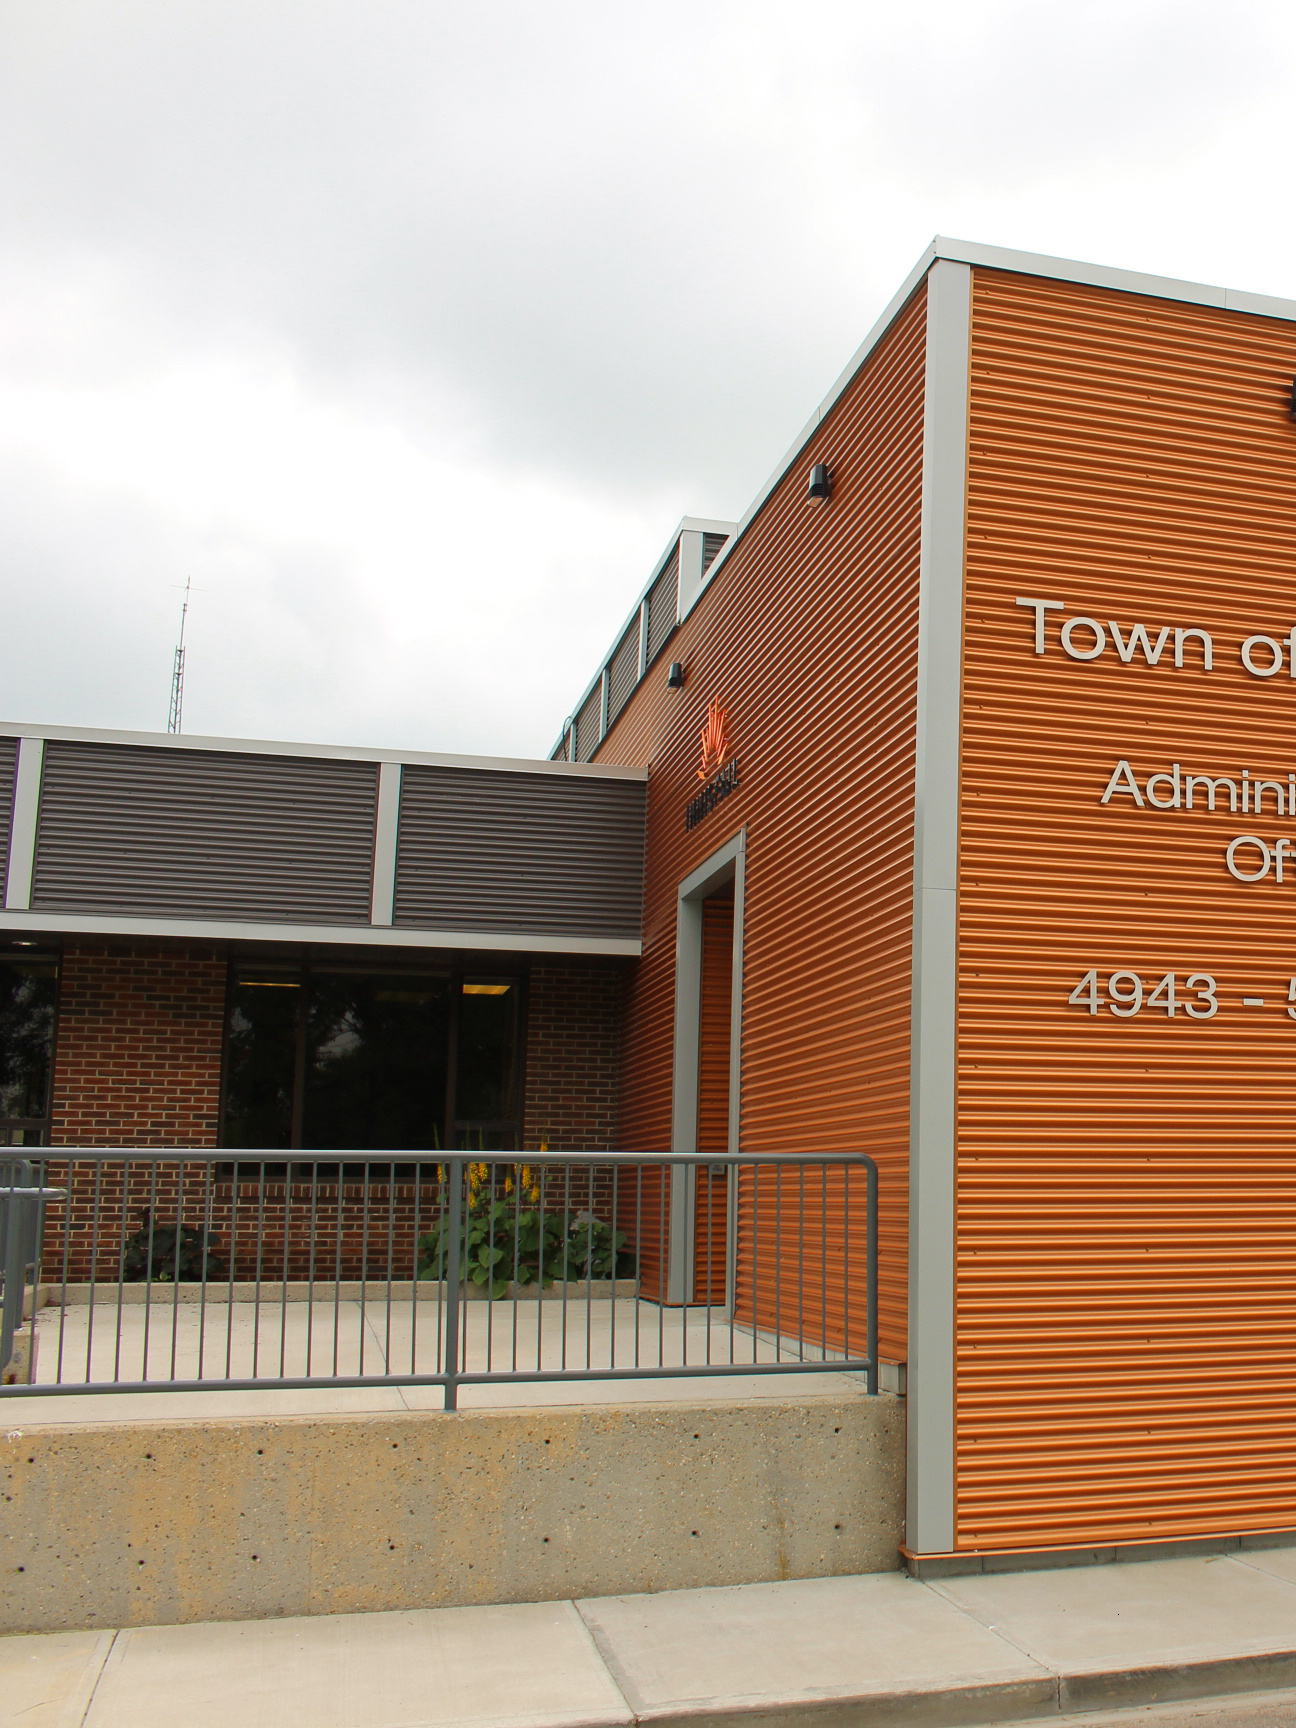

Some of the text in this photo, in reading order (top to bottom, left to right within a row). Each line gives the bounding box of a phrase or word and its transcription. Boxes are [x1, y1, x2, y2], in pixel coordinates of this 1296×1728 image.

[1016, 597, 1214, 671] Town
[1069, 970, 1219, 1019] 4943
[1243, 998, 1264, 1006] -
